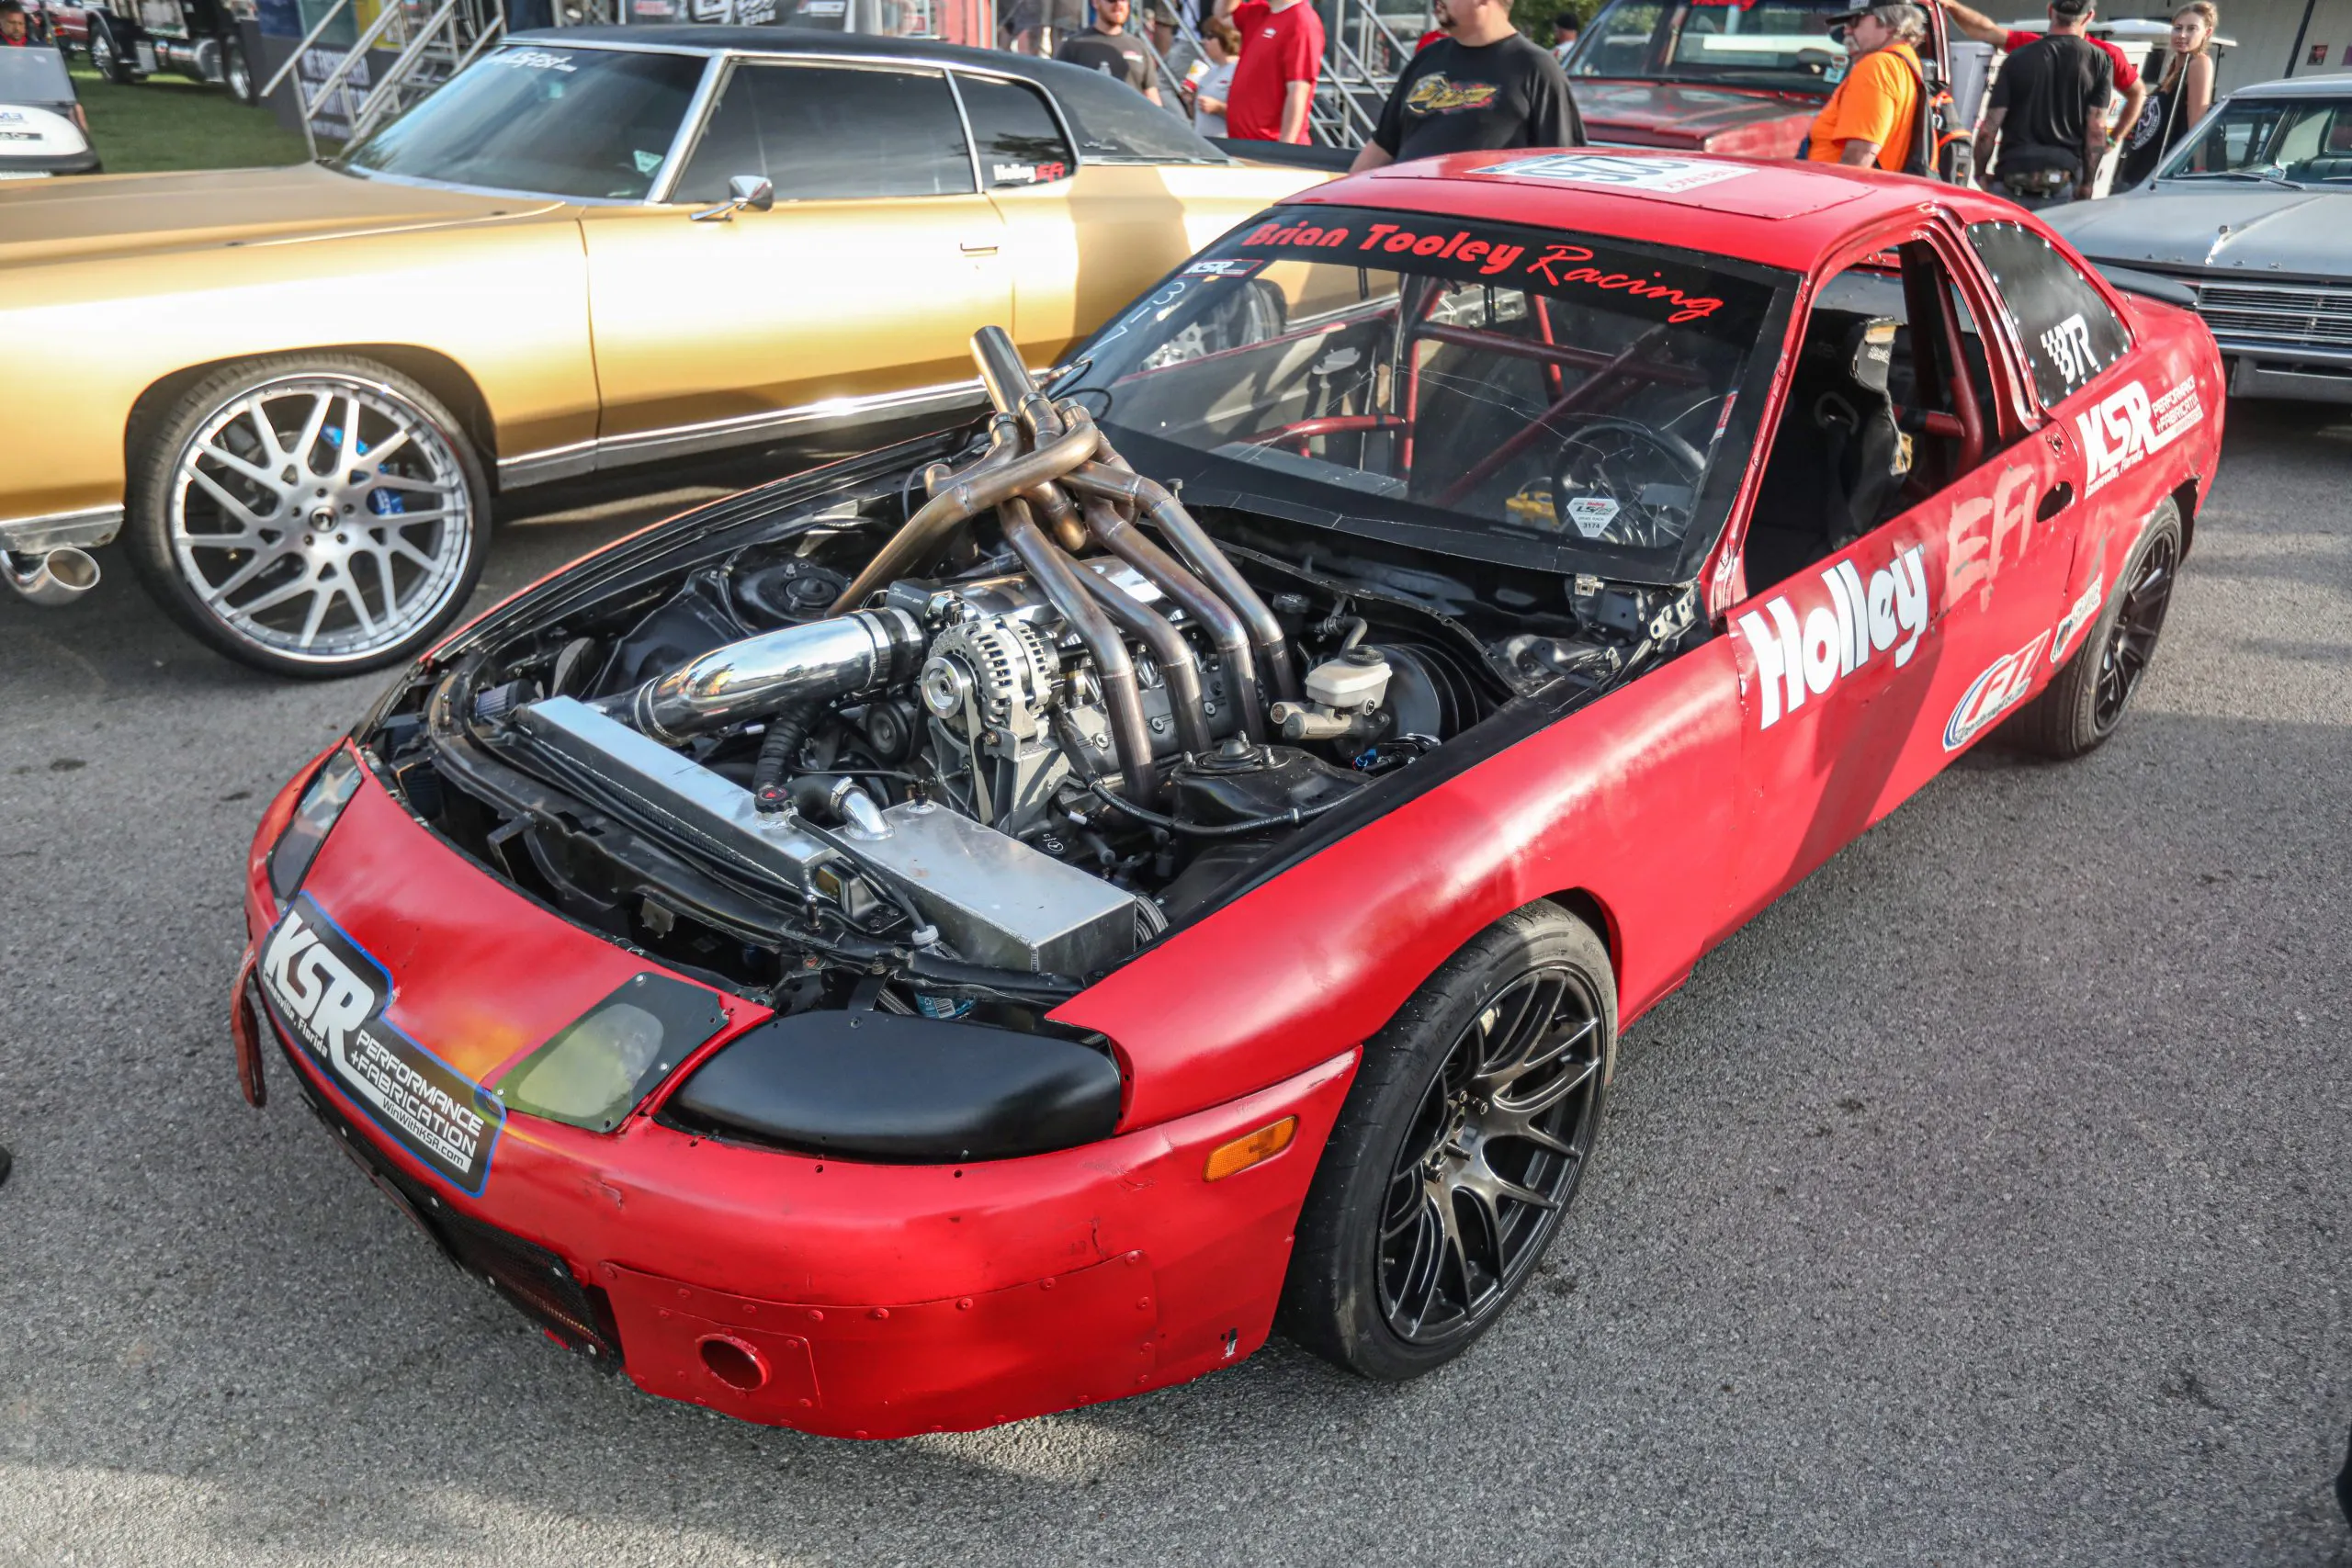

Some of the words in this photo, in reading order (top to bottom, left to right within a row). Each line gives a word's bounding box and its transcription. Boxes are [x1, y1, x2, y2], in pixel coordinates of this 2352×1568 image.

[1242, 220, 1349, 247] Brian
[1359, 223, 1525, 275] Tooley
[1526, 244, 1724, 323] Racing
[2041, 313, 2098, 384] BTR
[2075, 380, 2156, 484] KSR
[1739, 545, 1929, 730] Holley
[265, 910, 375, 1047] KSR
[298, 1019, 329, 1057] Florida
[356, 1029, 485, 1137] PERFORMANCE
[351, 1051, 478, 1158] +FABRICATION
[382, 1096, 464, 1167] WinWithKSR.com
